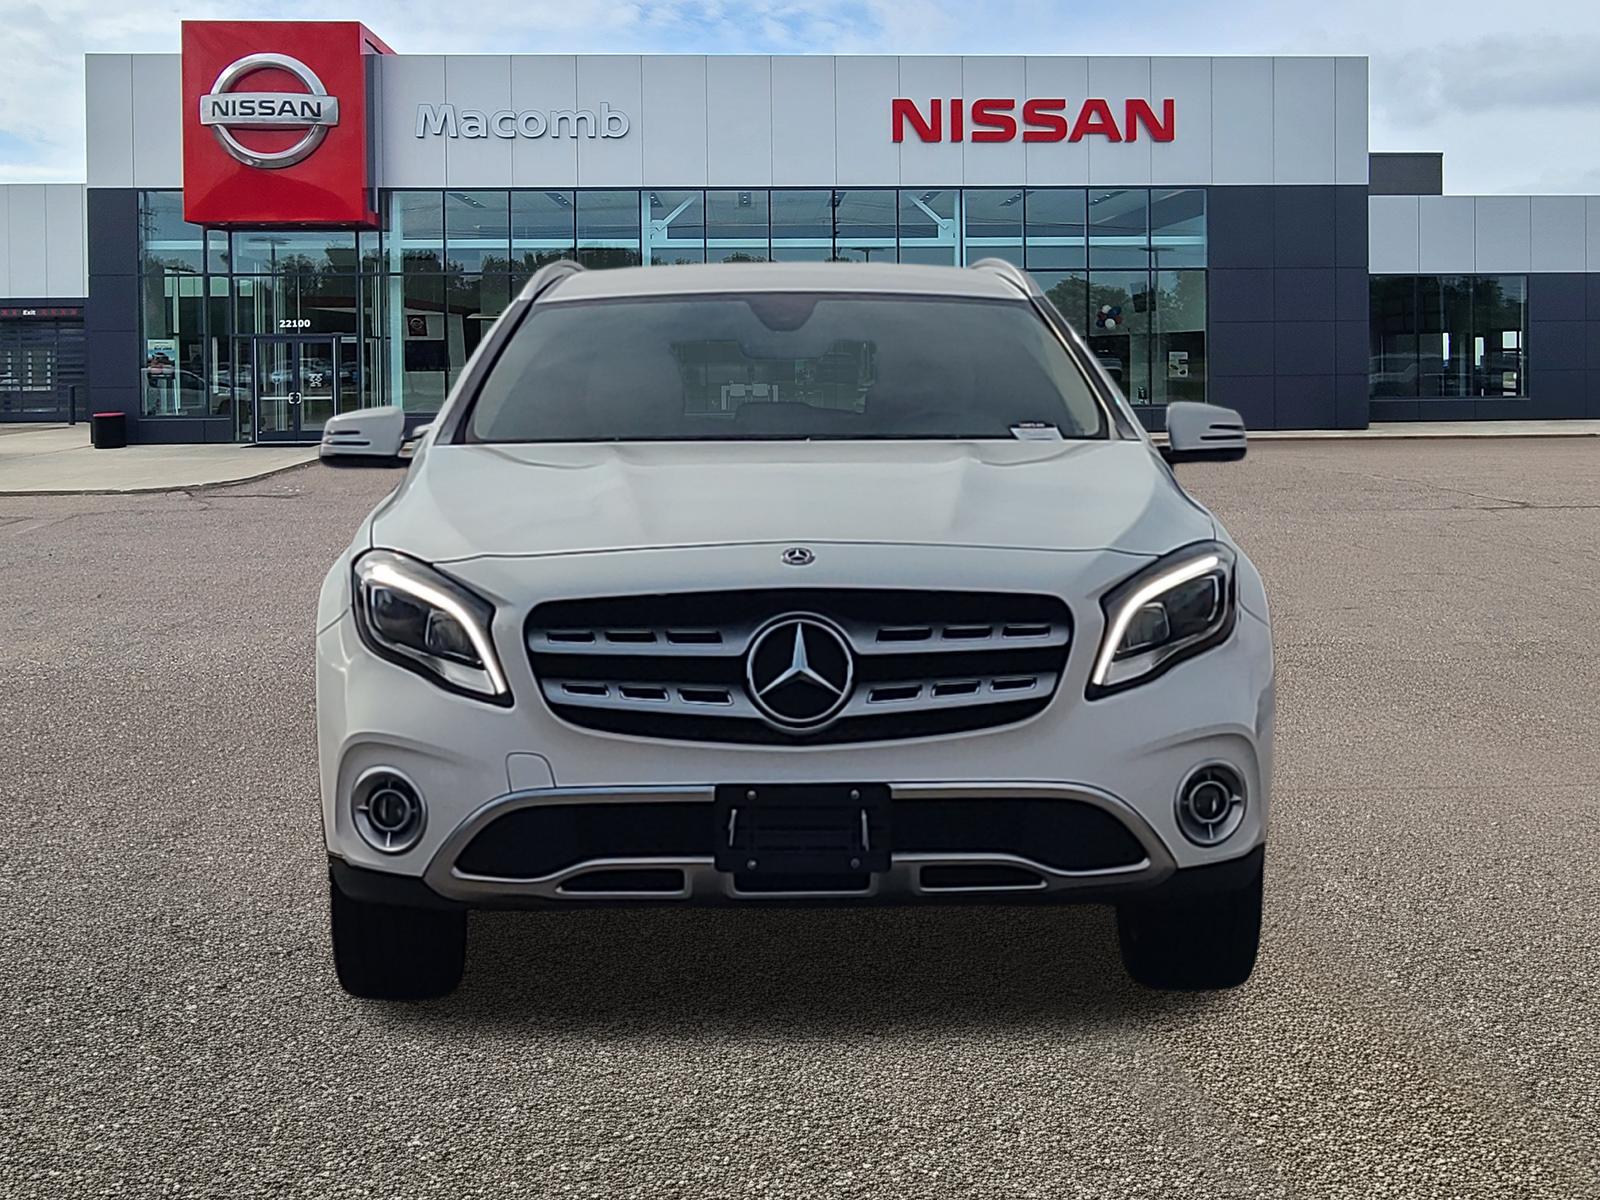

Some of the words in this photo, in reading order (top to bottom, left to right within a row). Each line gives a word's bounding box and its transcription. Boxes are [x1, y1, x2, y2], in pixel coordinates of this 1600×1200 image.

[211, 100, 321, 118] NISSAN
[415, 102, 630, 139] Macomb
[892, 98, 1175, 143] NISSAN
[279, 319, 311, 328] 22100
